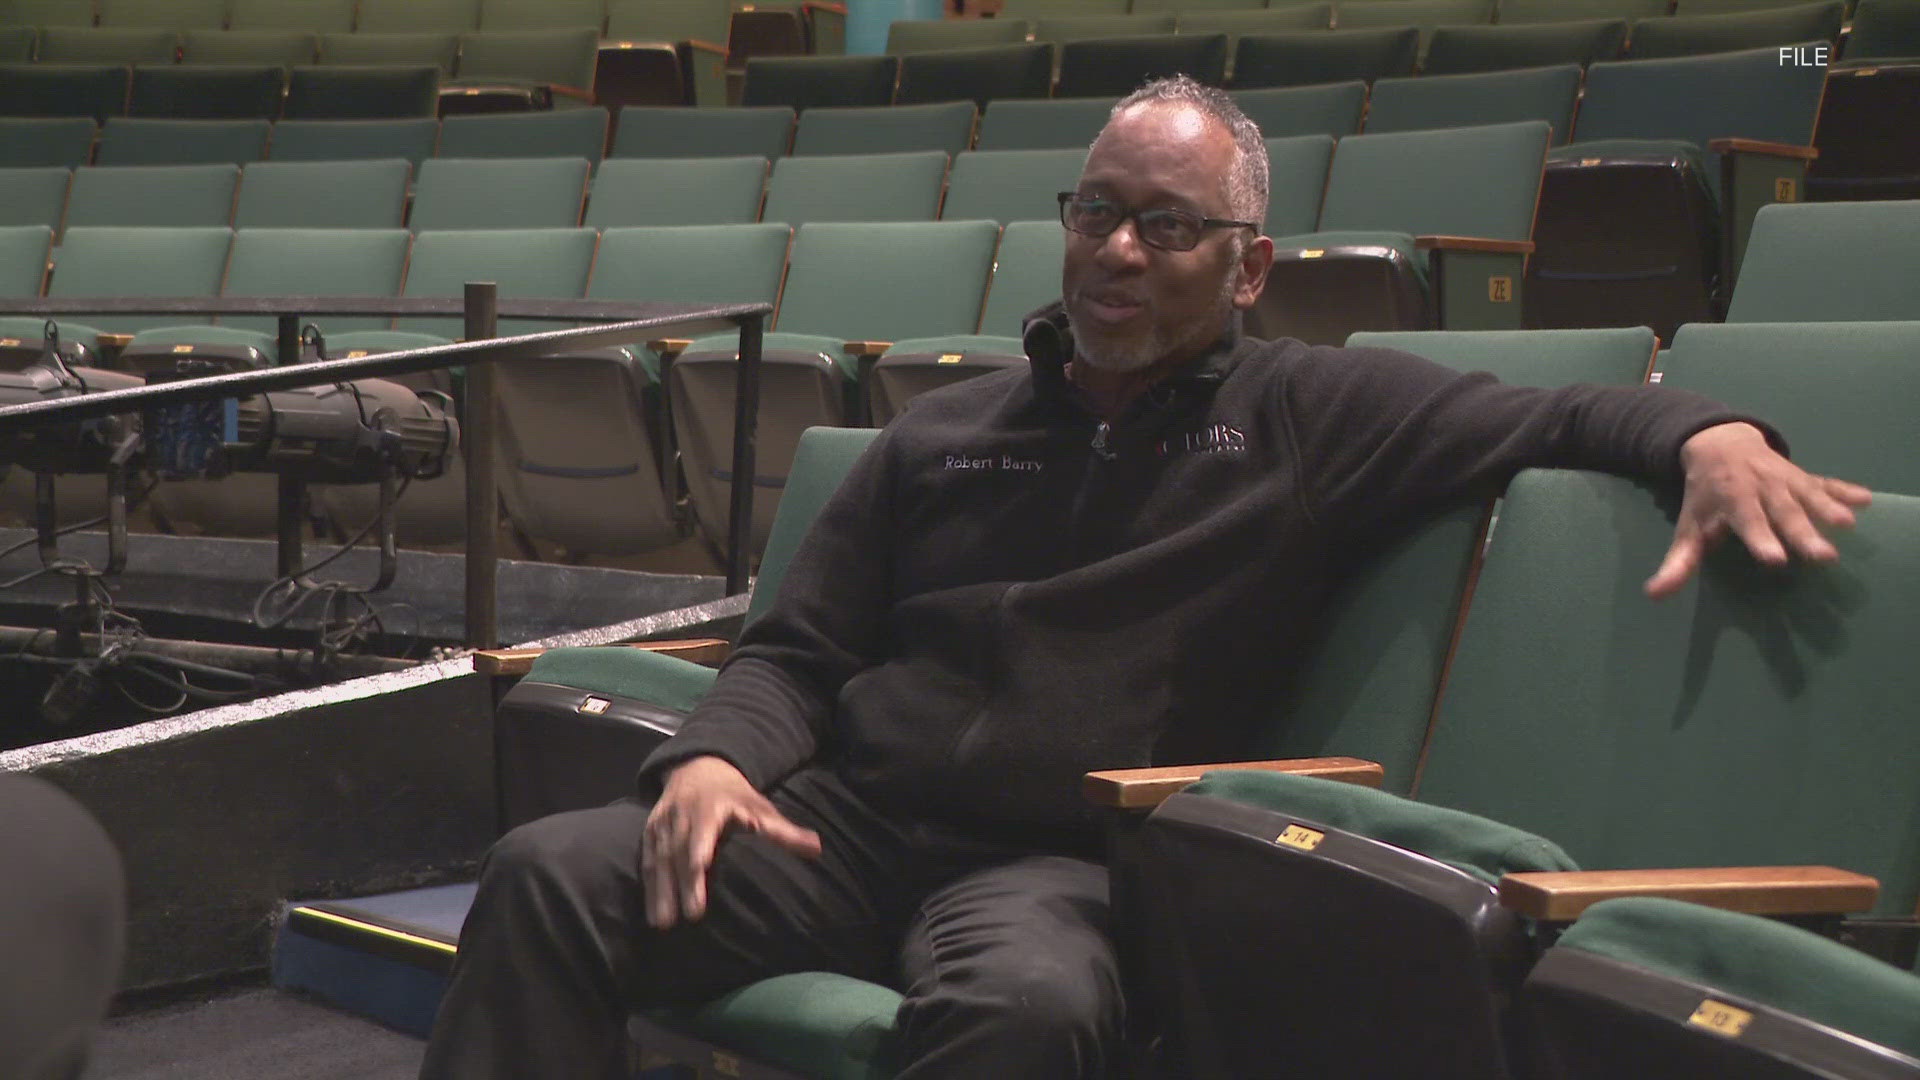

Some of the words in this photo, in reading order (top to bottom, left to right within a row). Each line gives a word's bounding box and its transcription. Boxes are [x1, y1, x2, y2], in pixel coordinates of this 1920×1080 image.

[1494, 279, 1506, 300] ZE
[944, 454, 993, 470] Robert
[1001, 455, 1043, 473] Barry
